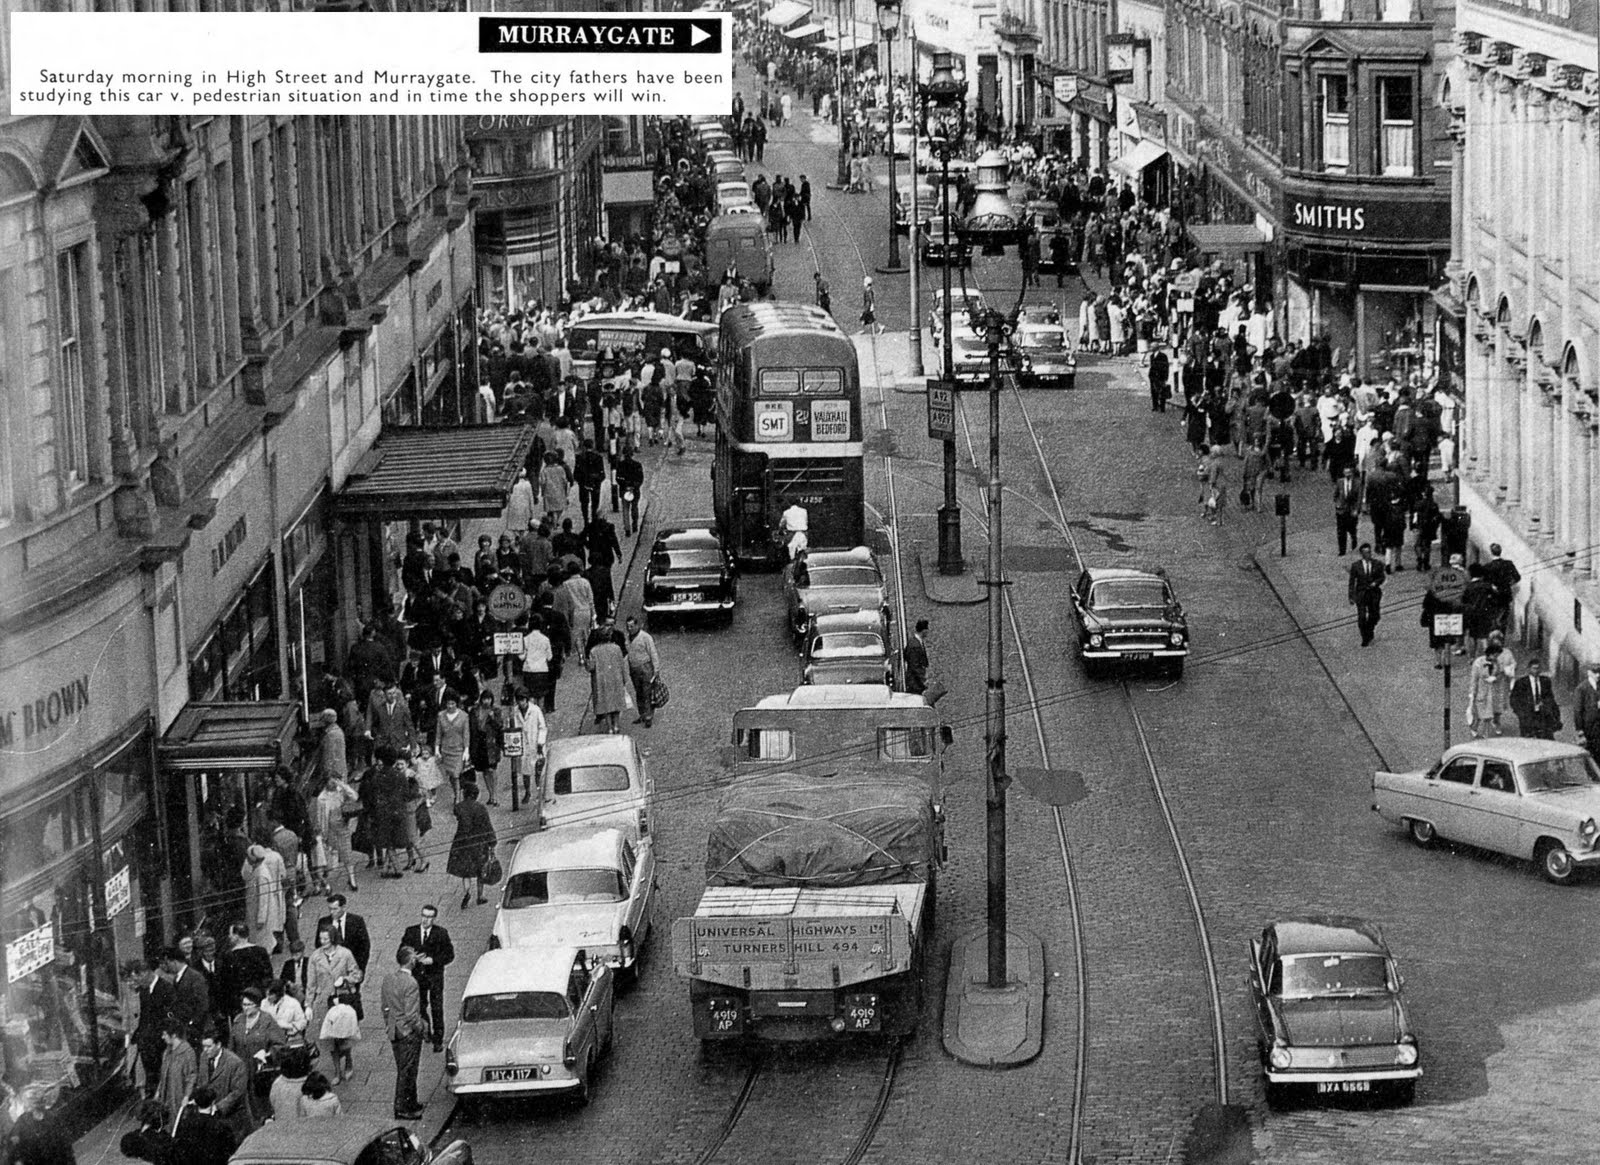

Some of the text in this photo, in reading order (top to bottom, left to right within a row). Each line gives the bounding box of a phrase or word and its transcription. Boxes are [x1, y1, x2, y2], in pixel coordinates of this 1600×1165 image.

[1295, 203, 1365, 231] SMITHS
[813, 411, 848, 422] VAUXHALL
[761, 417, 785, 431] SMT
[816, 423, 847, 435] BEDFORD
[1441, 574, 1457, 582] NO
[499, 592, 516, 601] NO
[493, 602, 523, 610] WAITING
[23, 674, 89, 737] BROWN
[697, 926, 775, 938] UNIVERSAL
[792, 925, 857, 936] HIGHWAYS
[722, 942, 859, 954] TURNERS HILL 494
[713, 1010, 738, 1021] 4919
[850, 1008, 875, 1019] 4919
[717, 1021, 733, 1031] AP
[855, 1019, 871, 1030] AP
[516, 1069, 531, 1079] 117
